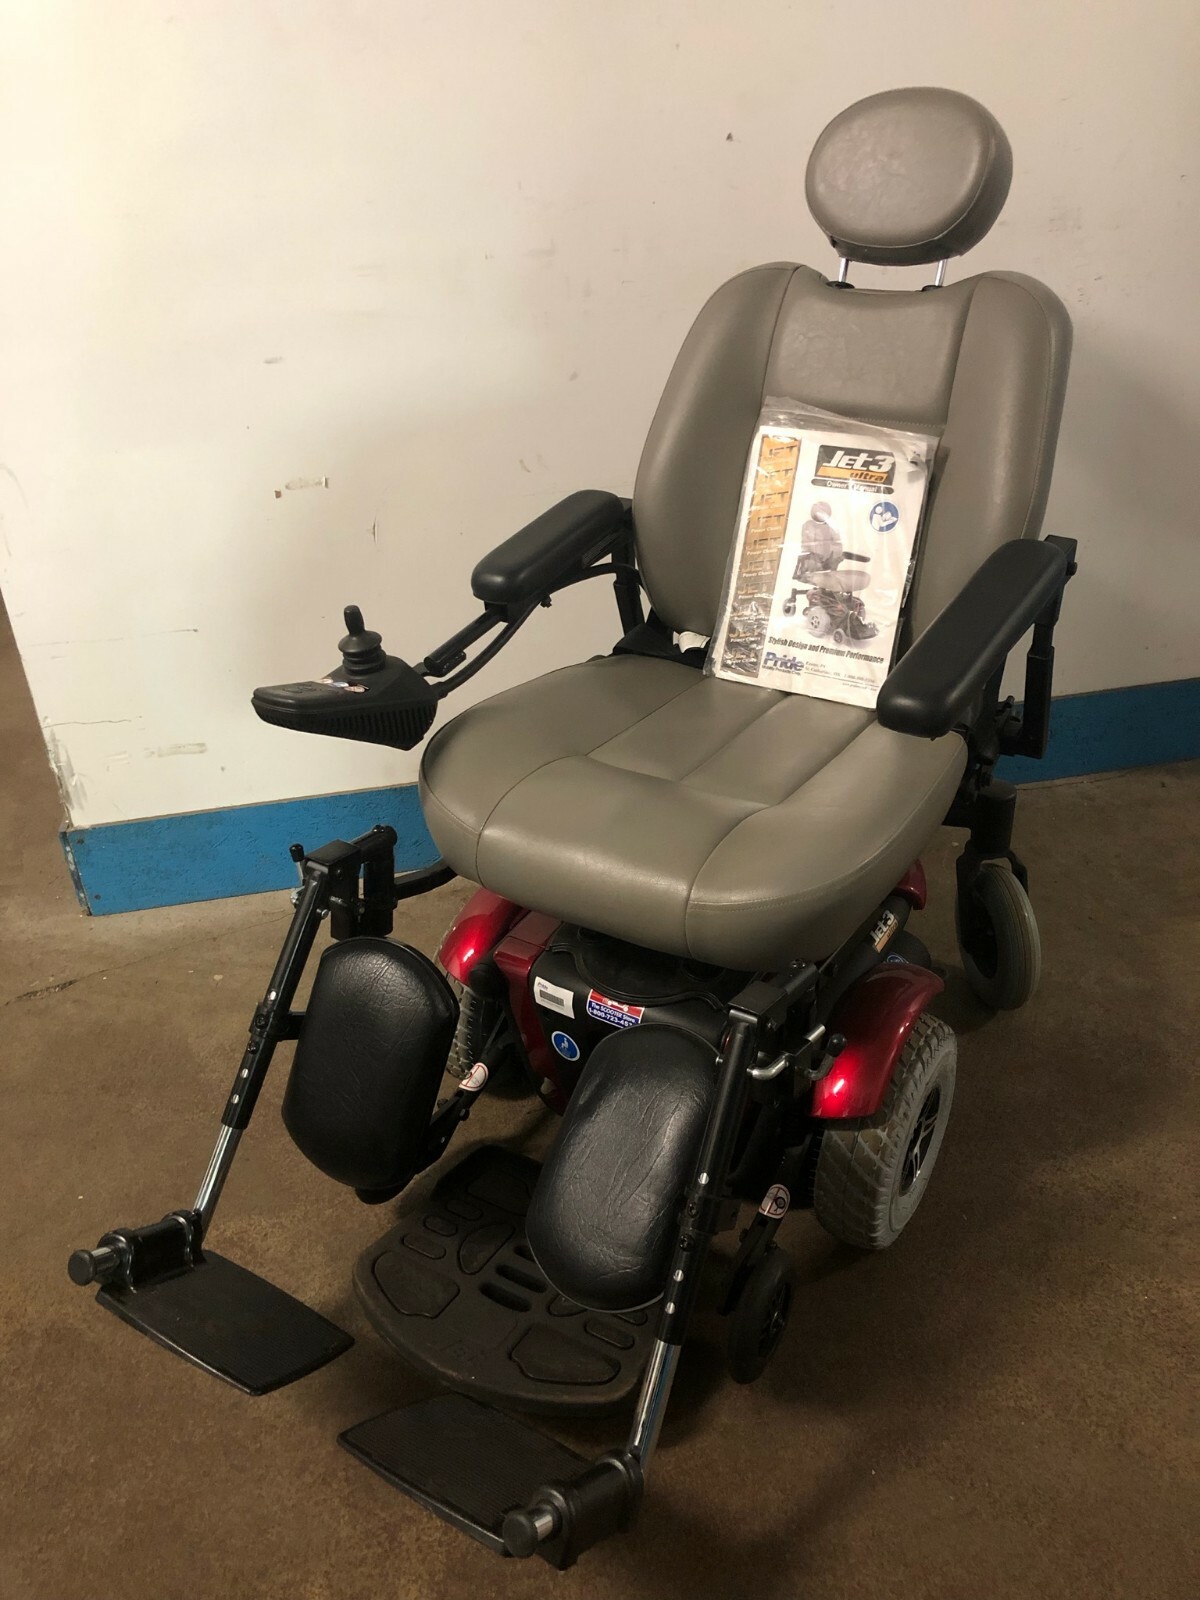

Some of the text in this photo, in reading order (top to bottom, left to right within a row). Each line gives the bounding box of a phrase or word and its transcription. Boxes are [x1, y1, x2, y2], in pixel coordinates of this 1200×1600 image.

[849, 471, 884, 482] ultra
[767, 636, 885, 664] Stylish Design and Premium Performance
[764, 651, 804, 672] Pride
[600, 1006, 622, 1018] SCOOTER
